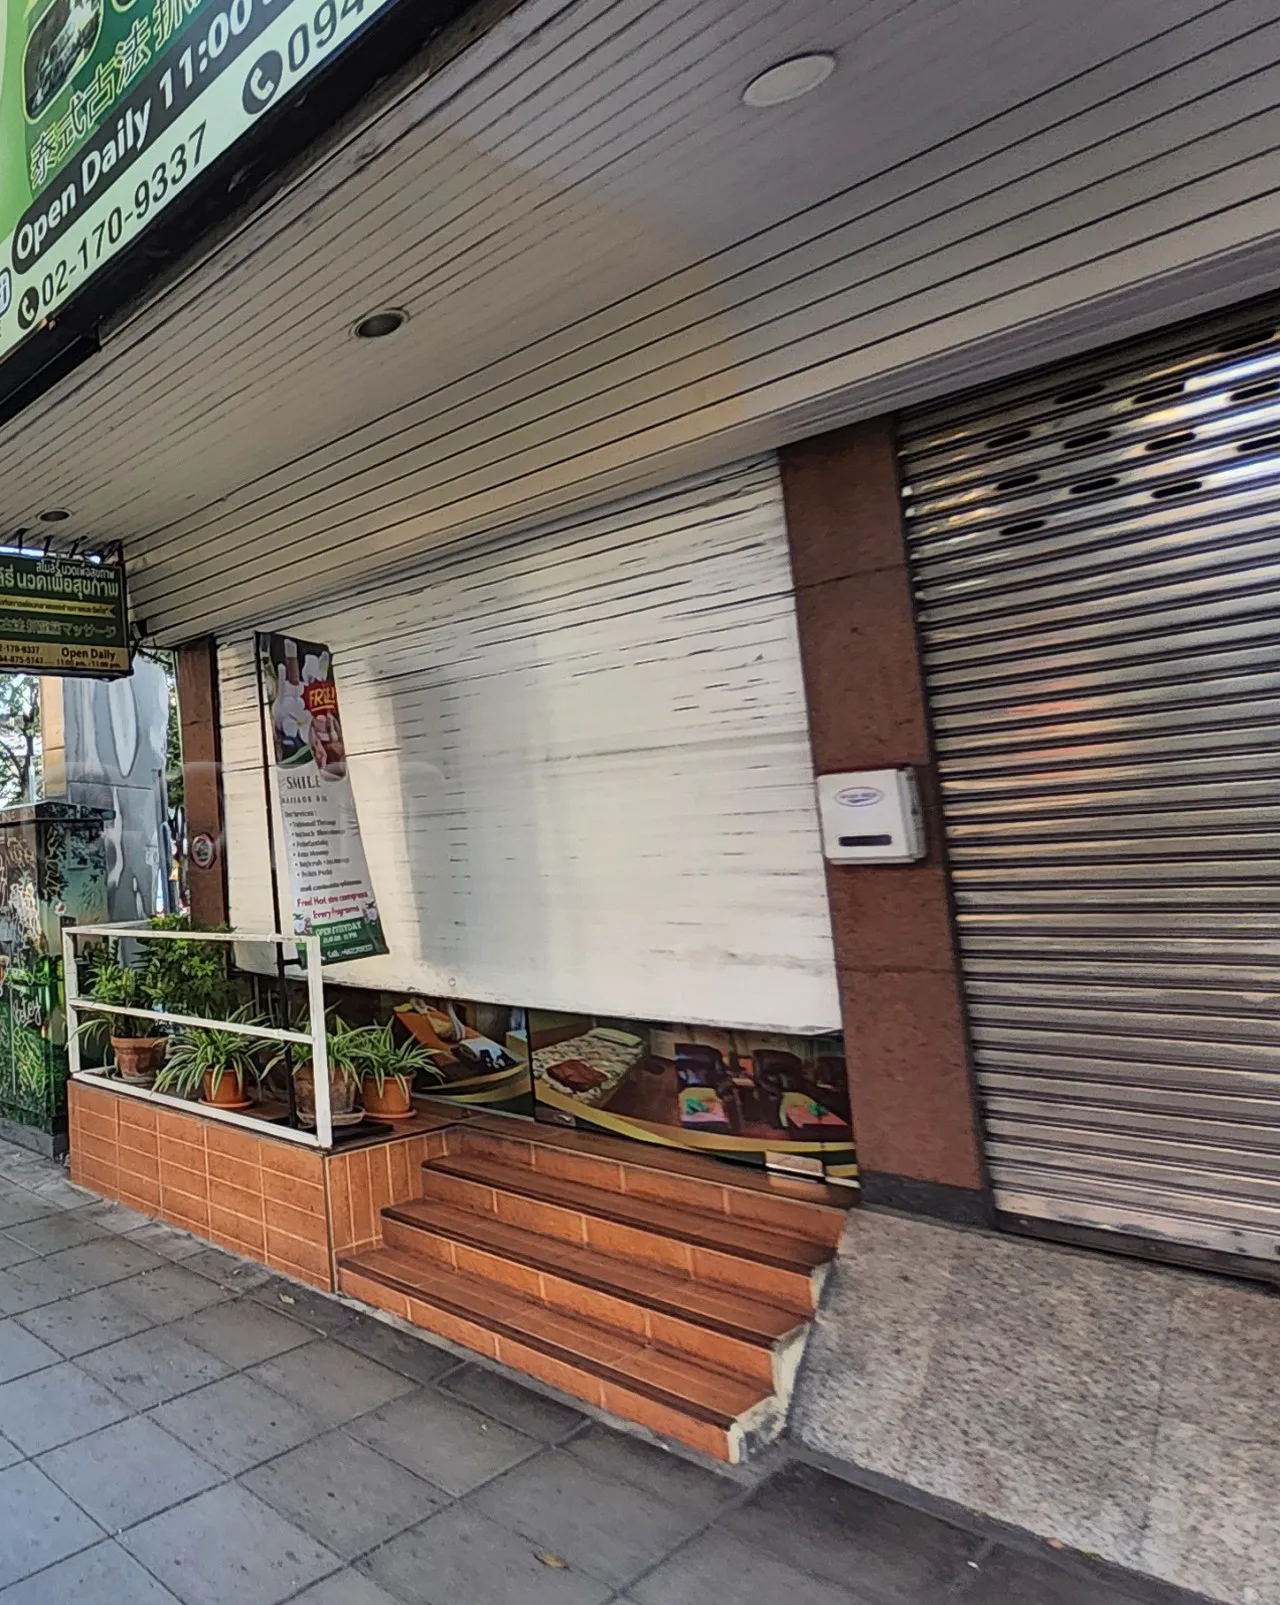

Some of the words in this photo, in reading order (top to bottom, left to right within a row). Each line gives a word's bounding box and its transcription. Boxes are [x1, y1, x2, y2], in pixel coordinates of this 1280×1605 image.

[17, 182, 77, 260] Open
[81, 98, 151, 196] Daily
[41, 119, 207, 307] 02-170-9337
[61, 647, 89, 659] Open
[90, 649, 116, 661] Daily
